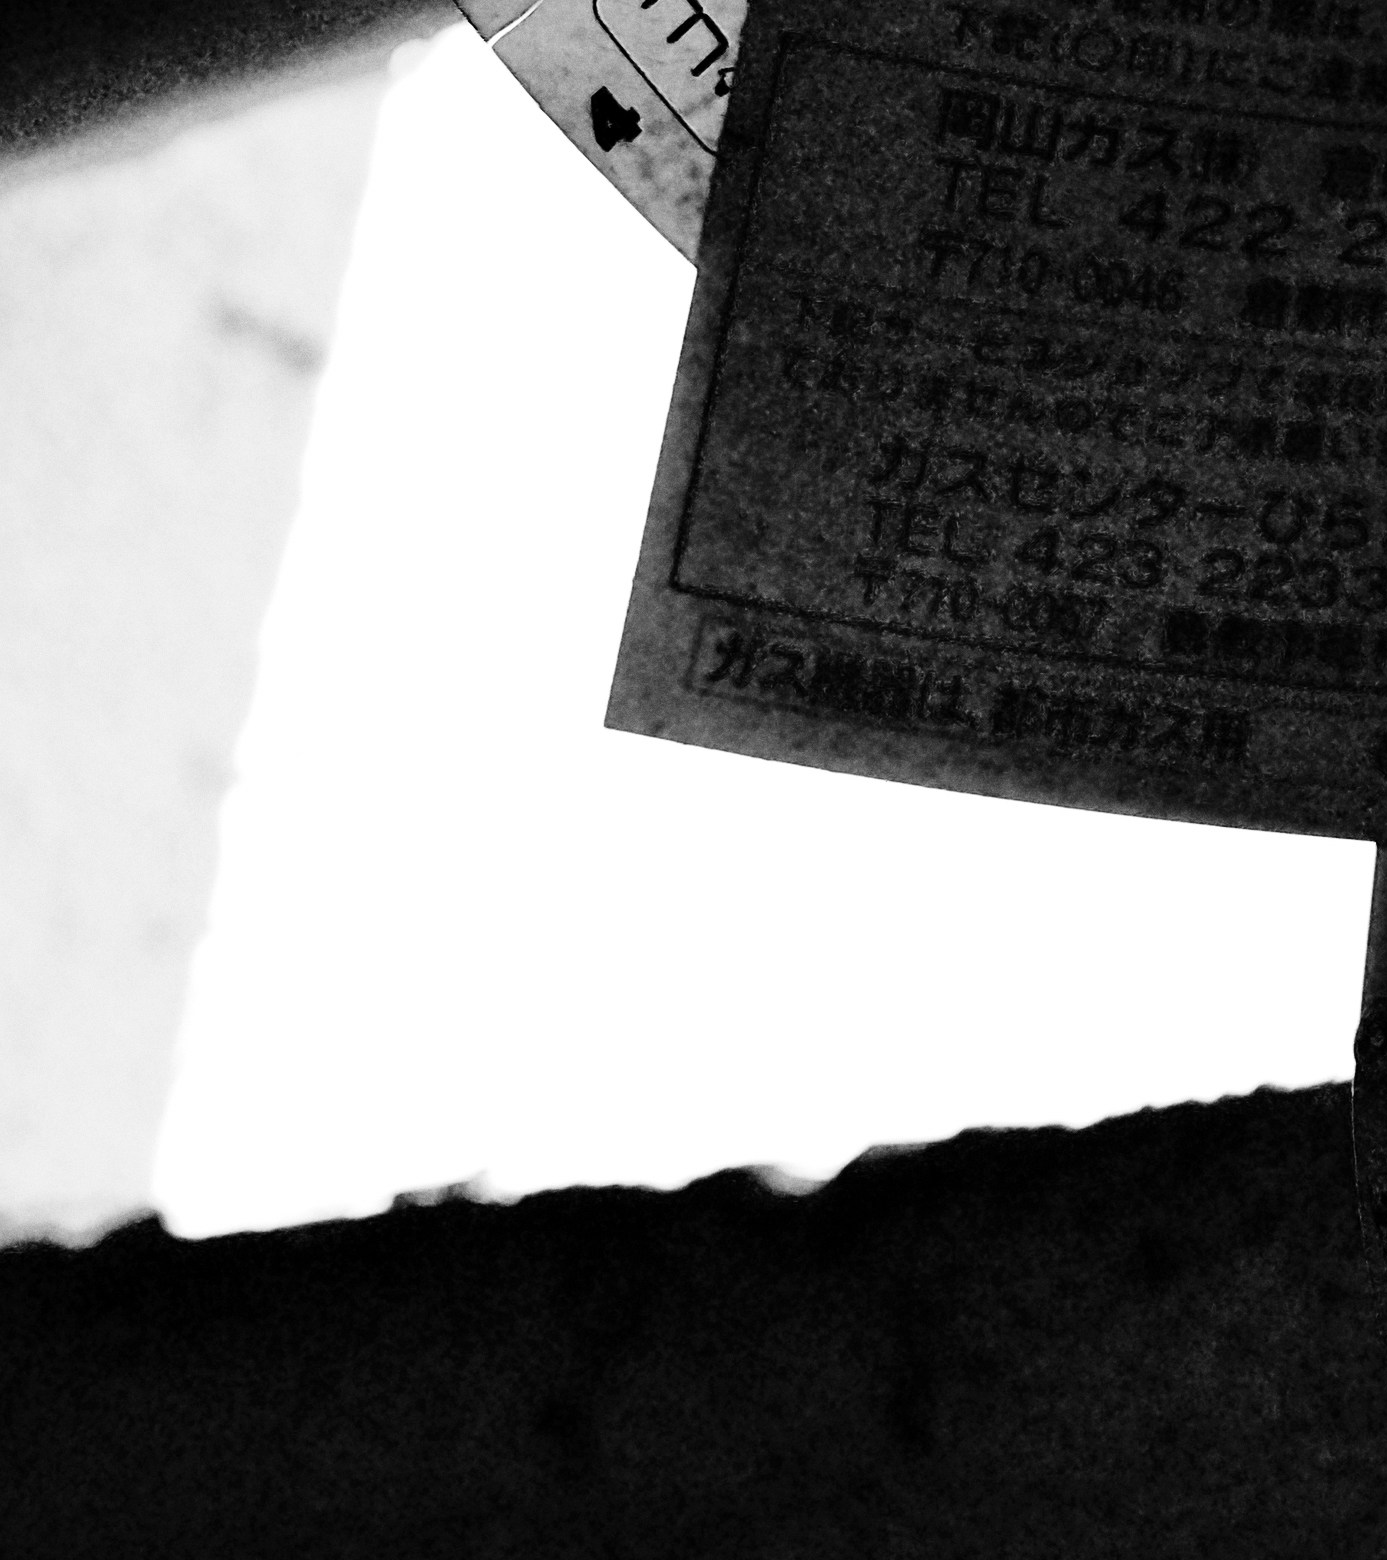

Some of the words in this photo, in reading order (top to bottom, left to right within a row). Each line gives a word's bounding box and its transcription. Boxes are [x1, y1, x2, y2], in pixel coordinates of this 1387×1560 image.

[590, 84, 642, 152] 4
[935, 153, 1066, 230] TEL
[866, 499, 988, 570] TEL
